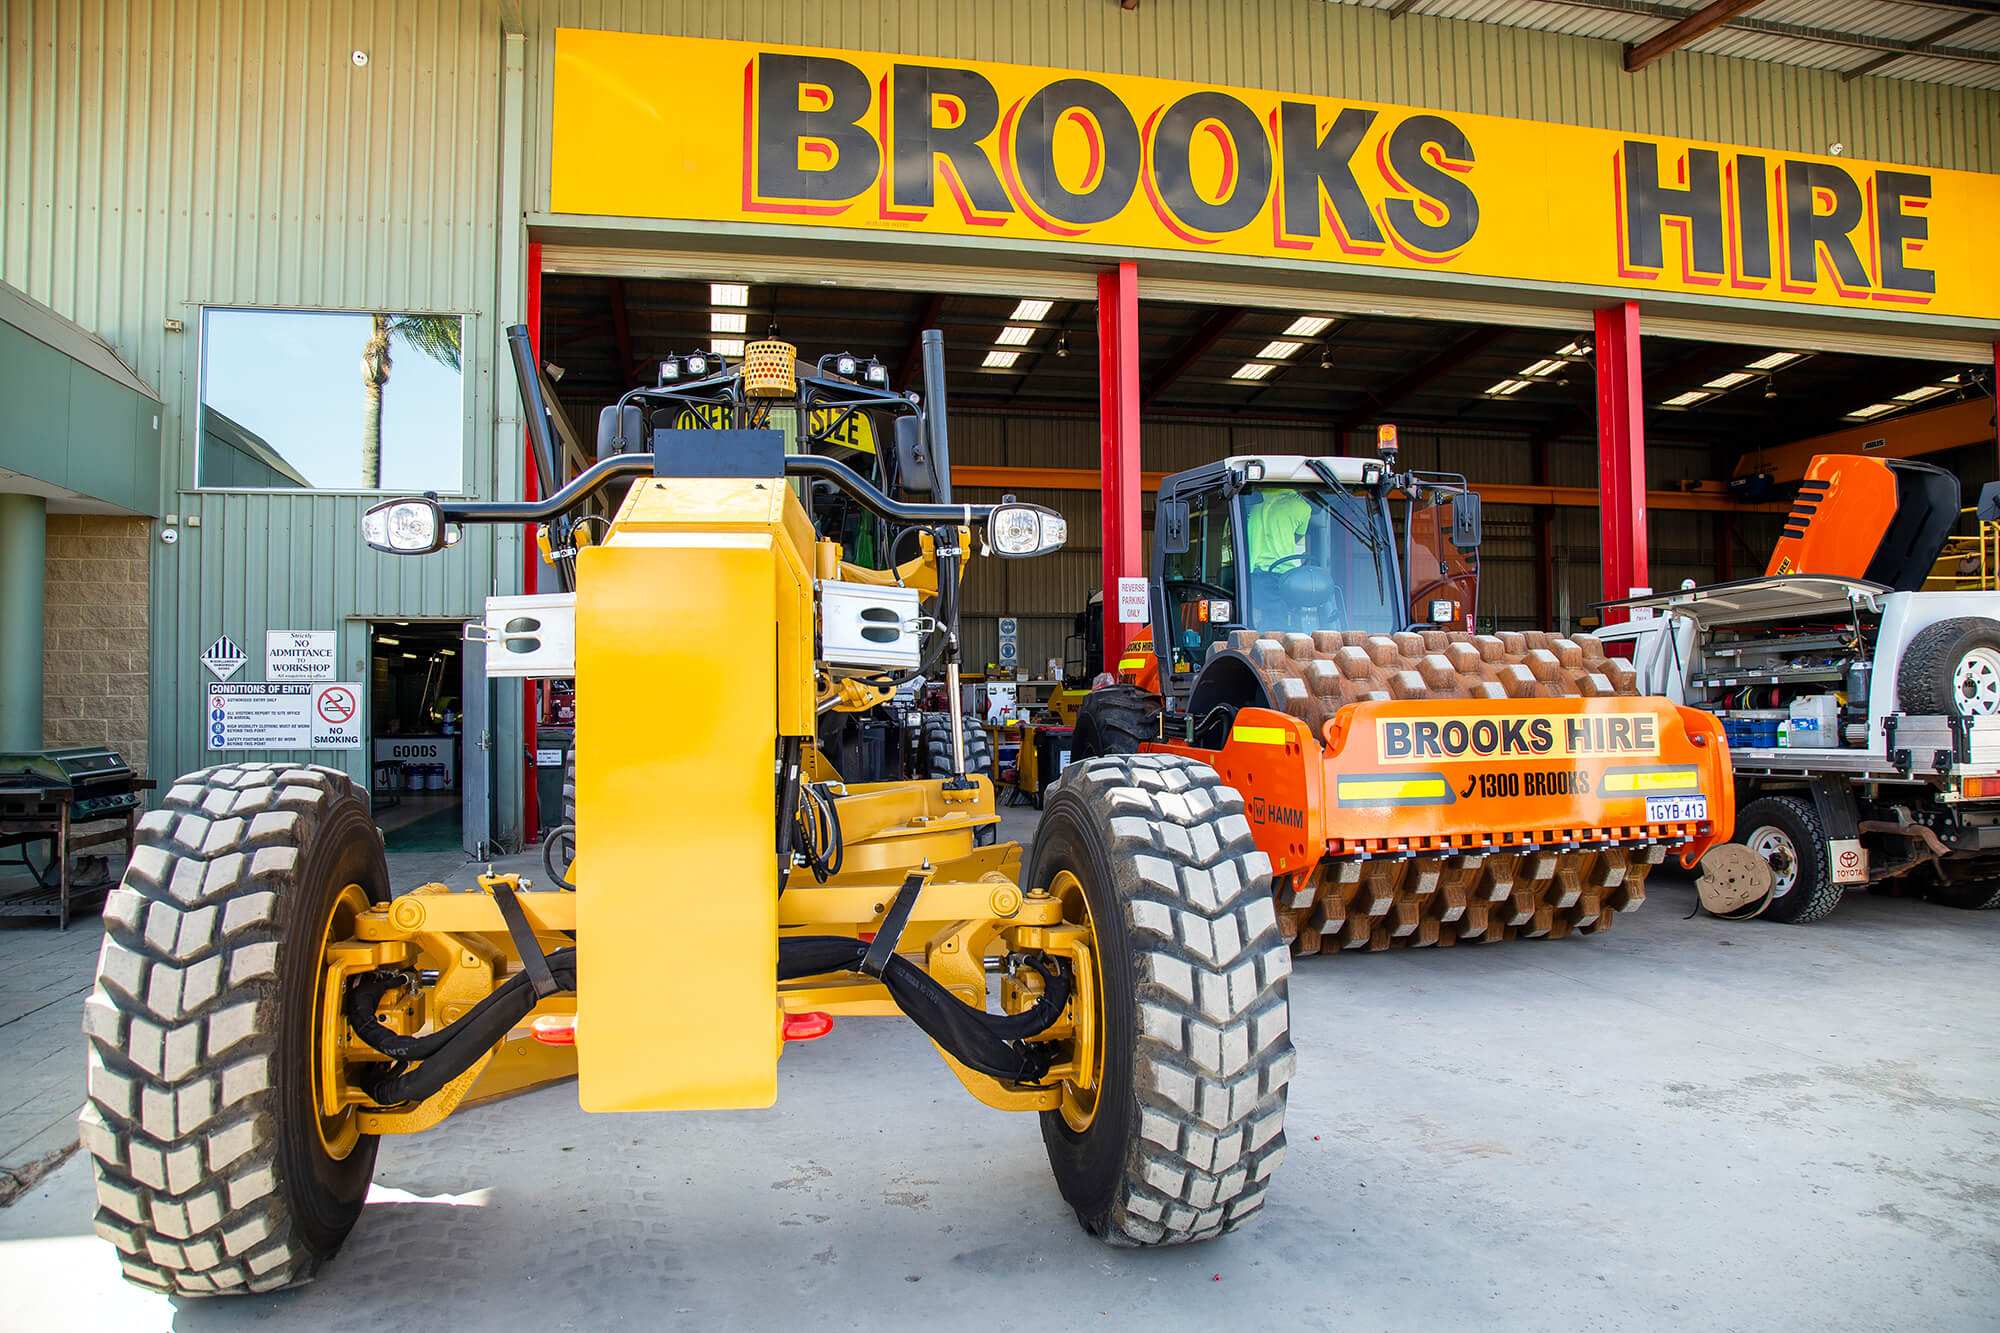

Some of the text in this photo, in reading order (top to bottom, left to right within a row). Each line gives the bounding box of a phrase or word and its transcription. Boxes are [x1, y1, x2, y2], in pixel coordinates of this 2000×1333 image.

[743, 52, 1937, 305] BROOKS HIRE
[1121, 583, 1145, 592] REVERSE
[1121, 596, 1145, 604] PARKING
[1127, 608, 1140, 617] ONLY
[294, 639, 309, 648] NO
[269, 649, 333, 657] ADMITTANCE
[272, 664, 330, 672] WORKSHOP
[211, 684, 311, 694] CONDITIONS OF ENTRY
[329, 727, 343, 735] NO
[314, 736, 359, 744] SMOKING
[1384, 715, 1657, 759] BROOKS HIRE
[393, 745, 437, 758] GOODS
[1478, 771, 1590, 798] 1300 BROOKS
[1268, 804, 1303, 829] HAMM
[1837, 869, 1863, 878] TOYOTA
